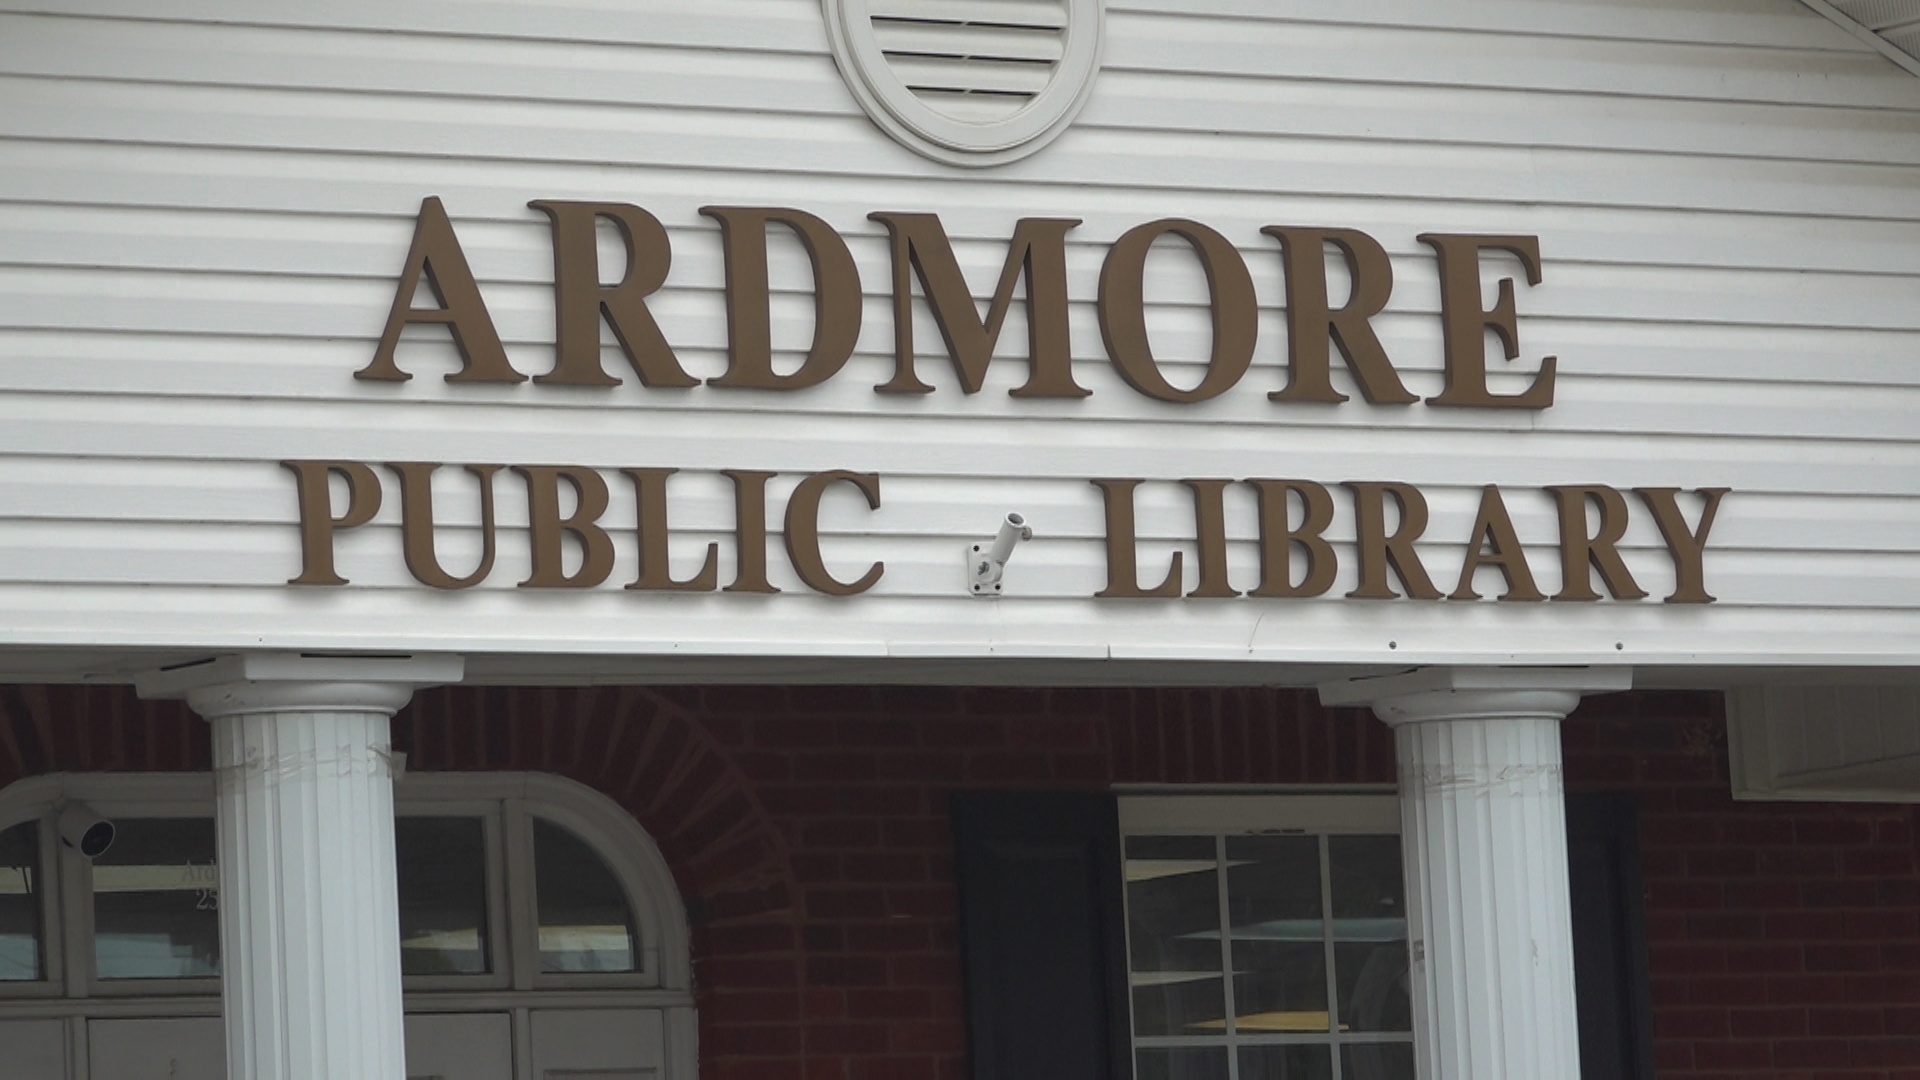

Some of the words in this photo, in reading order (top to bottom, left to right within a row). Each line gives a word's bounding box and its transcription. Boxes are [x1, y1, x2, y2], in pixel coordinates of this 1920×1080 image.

[354, 195, 1556, 408] ARDMORE
[280, 460, 883, 596] PUBLIC
[1090, 478, 1731, 604] LIBRARY
